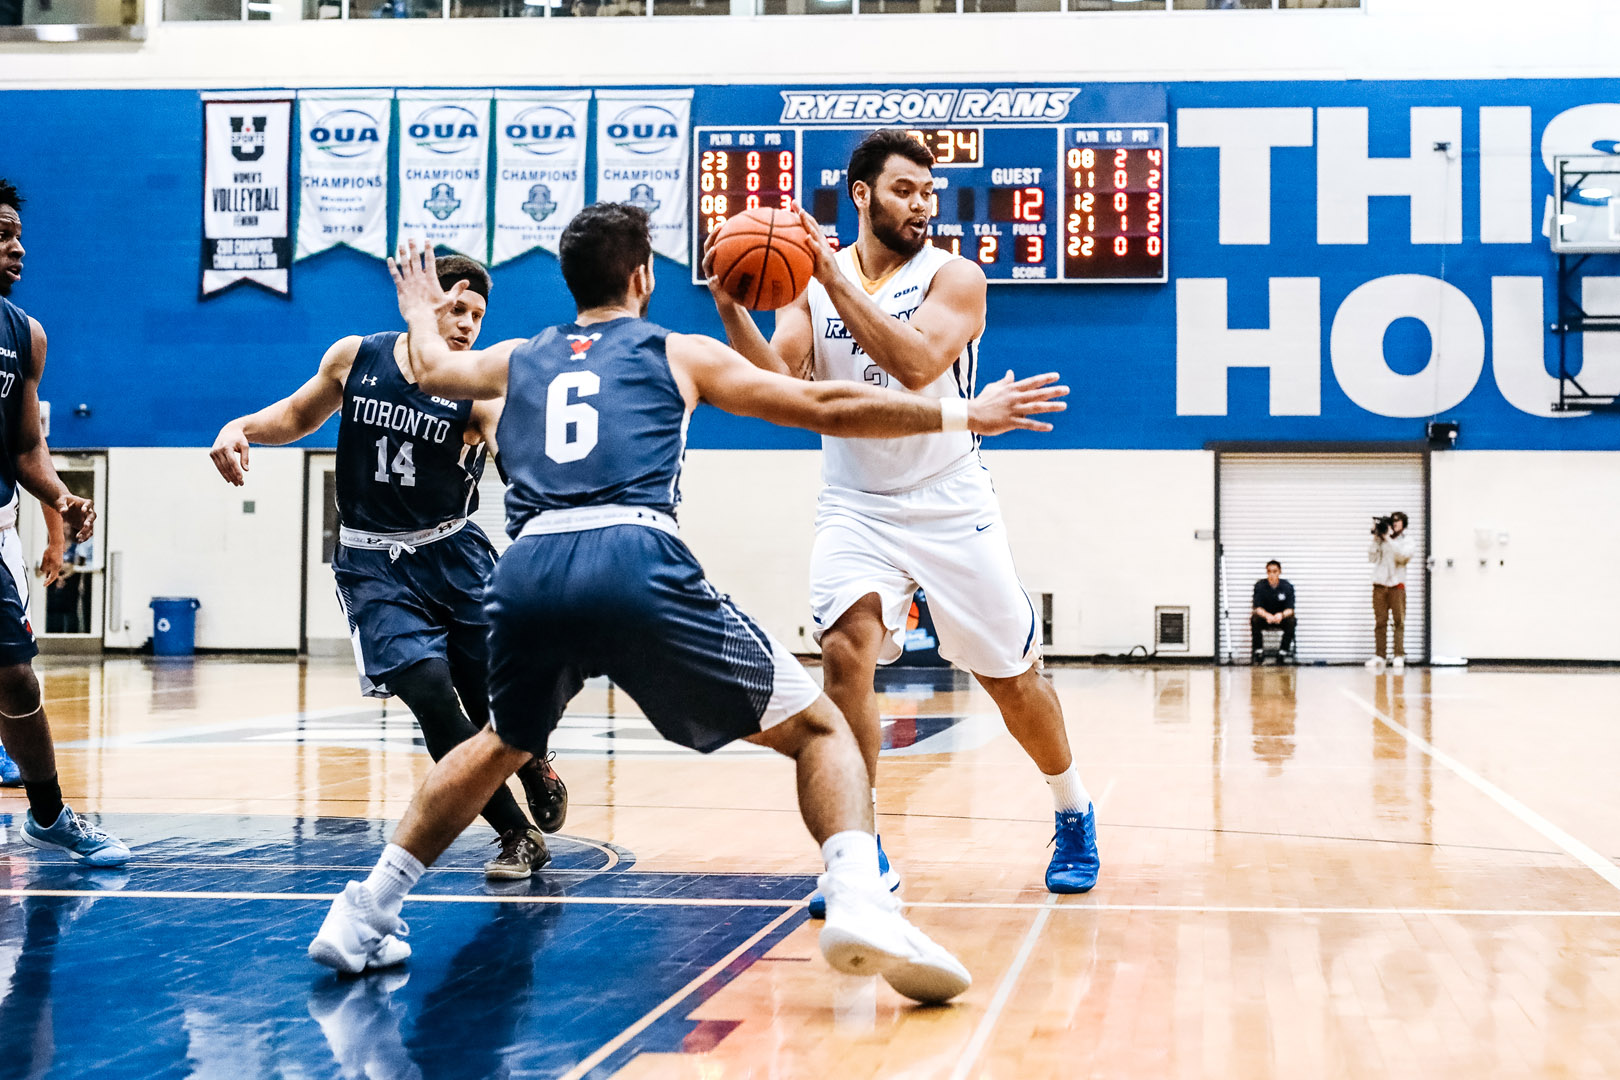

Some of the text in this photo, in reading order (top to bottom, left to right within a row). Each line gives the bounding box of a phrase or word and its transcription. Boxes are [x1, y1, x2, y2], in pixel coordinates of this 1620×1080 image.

[781, 88, 1081, 123] RYERSON RAMS
[309, 127, 379, 142] OUA
[408, 124, 478, 139] OUA
[505, 124, 577, 139] OUA
[606, 124, 678, 139] OUA
[701, 151, 728, 171] 23
[746, 151, 760, 171] 0
[778, 151, 793, 171] 0
[1067, 148, 1161, 169] 08 2 4
[233, 172, 262, 184] WOMEN'S
[301, 175, 382, 189] CHAMPIONS
[406, 169, 480, 181] CHAMPIONS
[502, 169, 577, 181] CHAMPIONS
[603, 168, 680, 181] CHAMPIONS
[701, 172, 793, 192] 07 0 0
[991, 168, 1043, 186] GUEST
[1073, 170, 1161, 190] 11 0 2
[212, 187, 279, 212] VOLLEYBALL
[701, 194, 728, 215] 08
[1013, 188, 1044, 221] 12
[1073, 192, 1161, 213] 12 0 2
[1012, 224, 1047, 236] FOULS
[1067, 214, 1161, 234] 21 1 2
[980, 235, 997, 264] 2
[1026, 235, 1043, 263] 3
[1067, 235, 1161, 256] 22 0 0
[1012, 266, 1047, 279] SCORE
[893, 285, 919, 299] OUA
[430, 395, 458, 411] OUA
[352, 395, 450, 444] TORONTO
[545, 369, 601, 464] 6
[374, 435, 416, 487] 14
